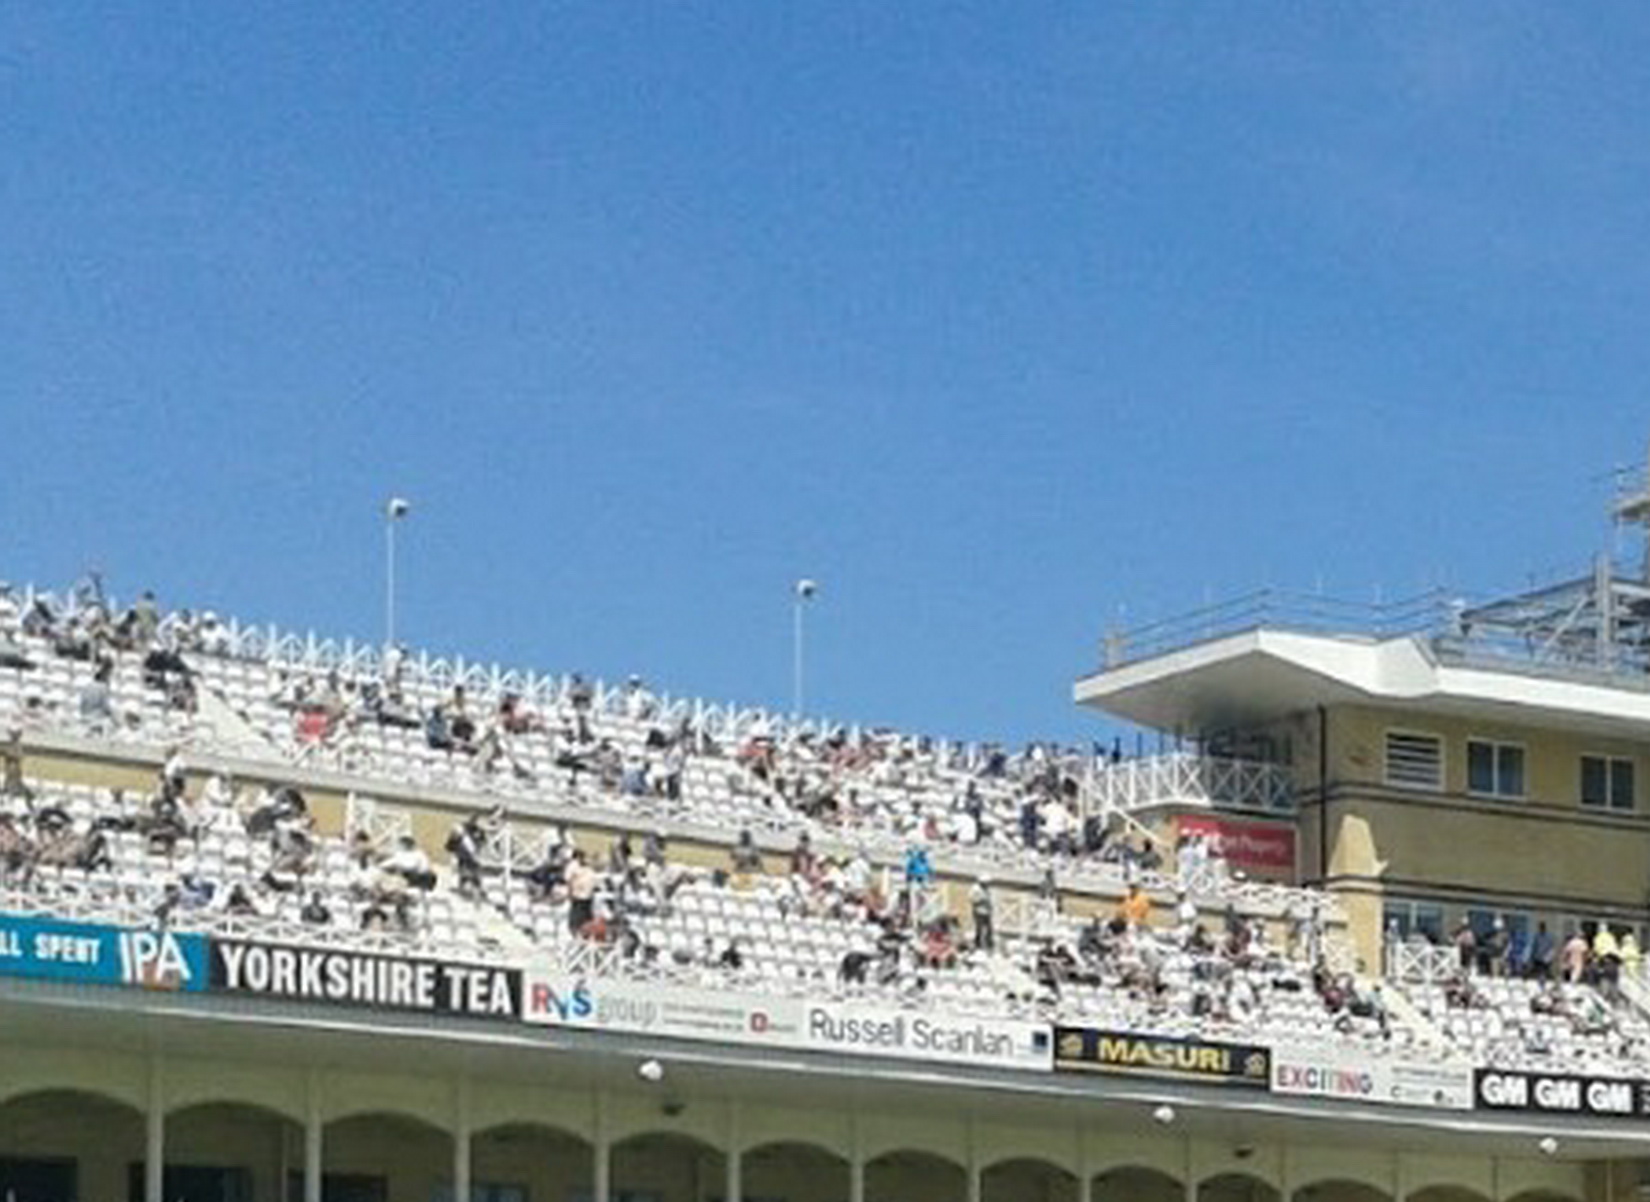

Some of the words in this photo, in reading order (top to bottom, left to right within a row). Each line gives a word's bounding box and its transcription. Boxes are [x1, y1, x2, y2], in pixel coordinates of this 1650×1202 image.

[117, 930, 192, 984] IPA
[218, 941, 434, 1009] YORKSHIRE
[443, 966, 513, 1016] TEA
[809, 1007, 905, 1047] Russell
[911, 1018, 1014, 1057] Scanlan
[1099, 1038, 1231, 1072] MASURI
[1276, 1065, 1374, 1095] EXCITING
[1481, 1073, 1528, 1107] GM
[1534, 1078, 1581, 1111] GM
[1587, 1081, 1634, 1114] GM
